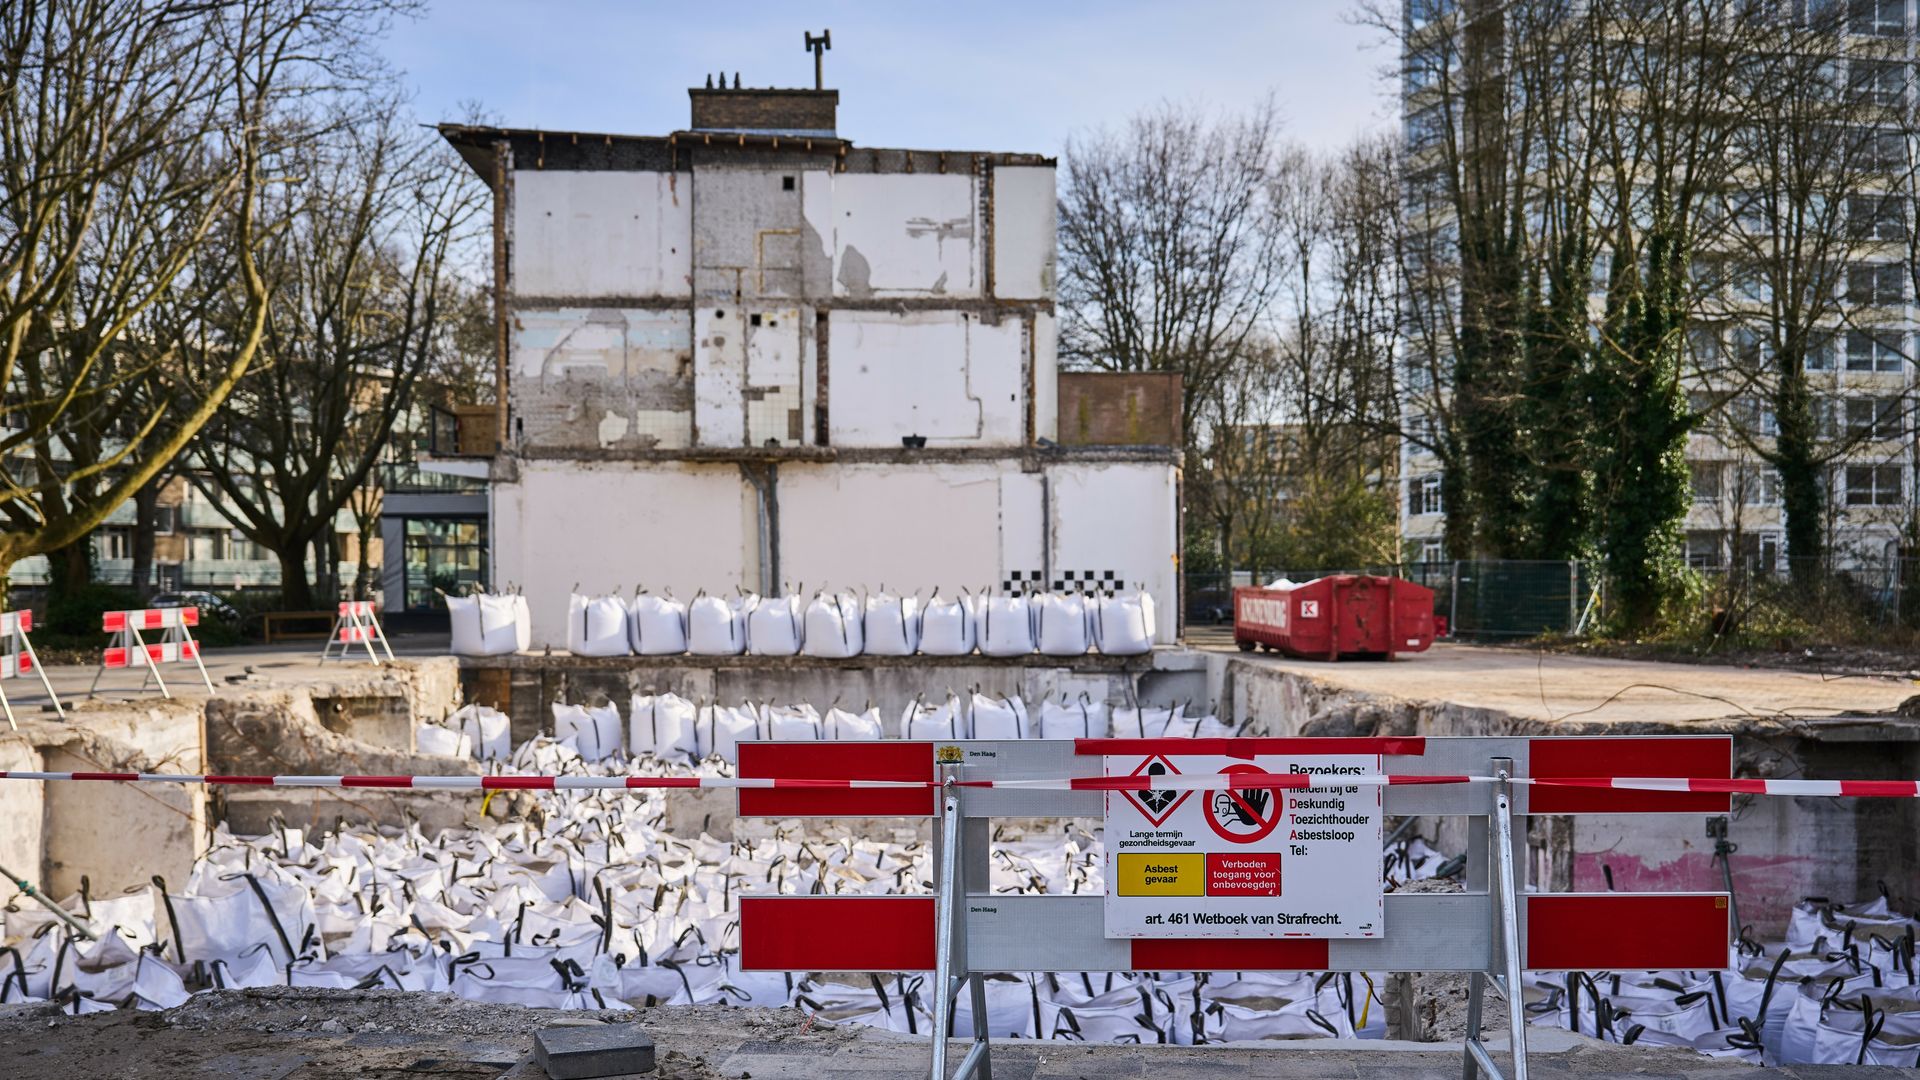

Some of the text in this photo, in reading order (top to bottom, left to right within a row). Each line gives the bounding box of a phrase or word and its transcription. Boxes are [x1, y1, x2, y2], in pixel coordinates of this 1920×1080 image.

[1290, 764, 1365, 775] Bezoekers:
[1290, 798, 1344, 811] Deskundig
[1290, 814, 1369, 824] Toezichthouder
[1130, 830, 1182, 840] Lange termijn
[1290, 830, 1354, 842] Asbestsloop
[1119, 838, 1195, 848] gezondheidsgevaar
[1290, 845, 1307, 855] Tel:
[1145, 865, 1178, 874] Asbest
[1222, 861, 1266, 869] Verboden
[1145, 877, 1177, 885] gevaar
[1214, 872, 1251, 880] toegang
[1213, 881, 1275, 889] onbevoegden
[1146, 913, 1341, 924] art. 461 Wetboek van Strafrecht.
